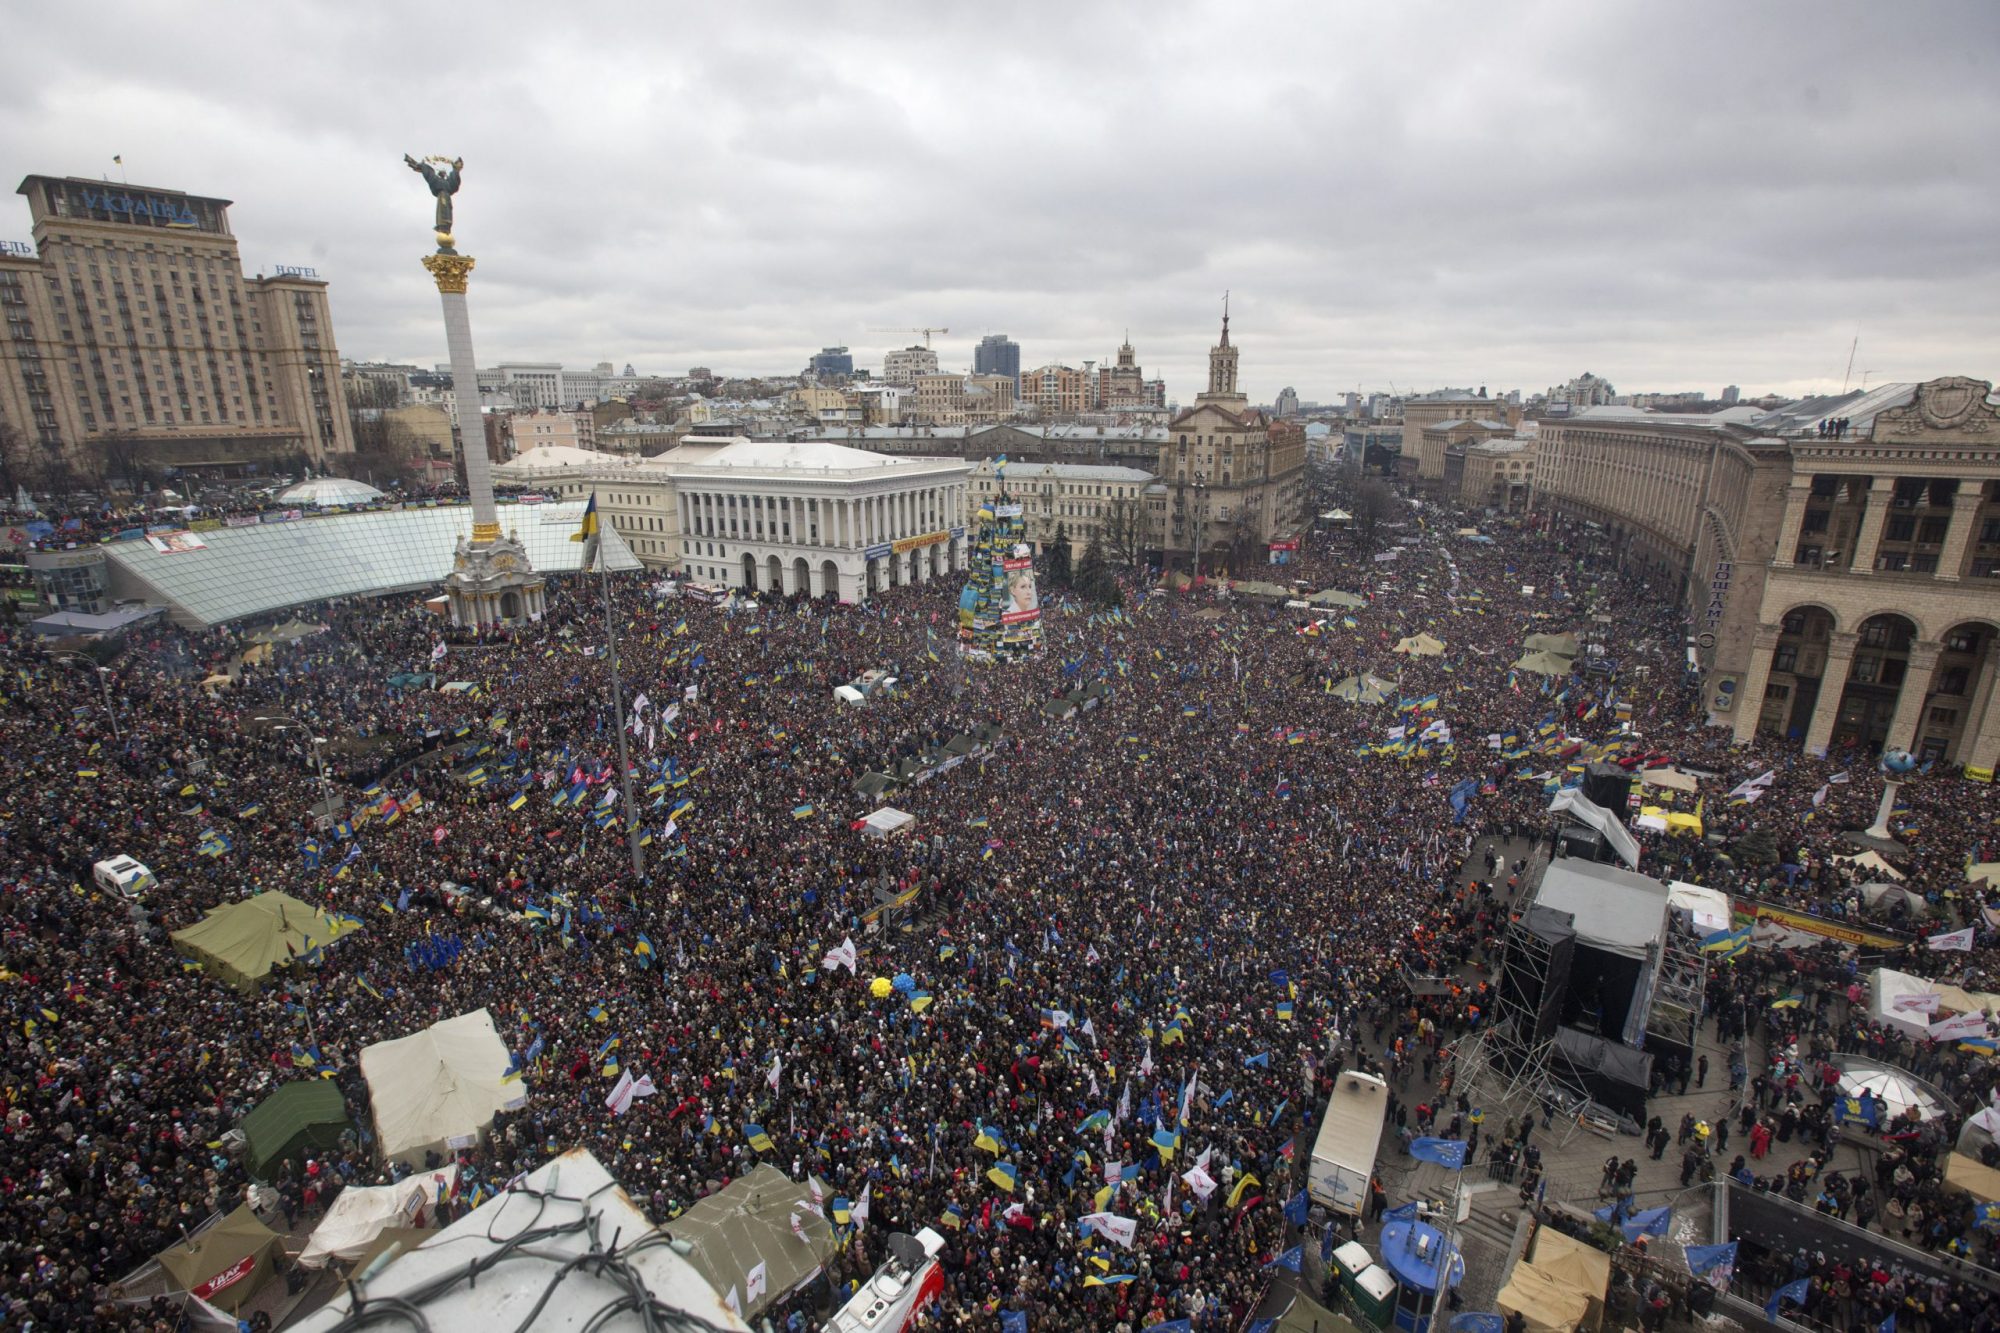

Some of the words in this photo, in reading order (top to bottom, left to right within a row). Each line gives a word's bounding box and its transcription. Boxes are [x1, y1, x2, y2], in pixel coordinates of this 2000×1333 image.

[82, 190, 194, 218] УКРАЇНА
[275, 265, 320, 277] HOTEL
[1706, 563, 1730, 627] ПОШТАМТ
